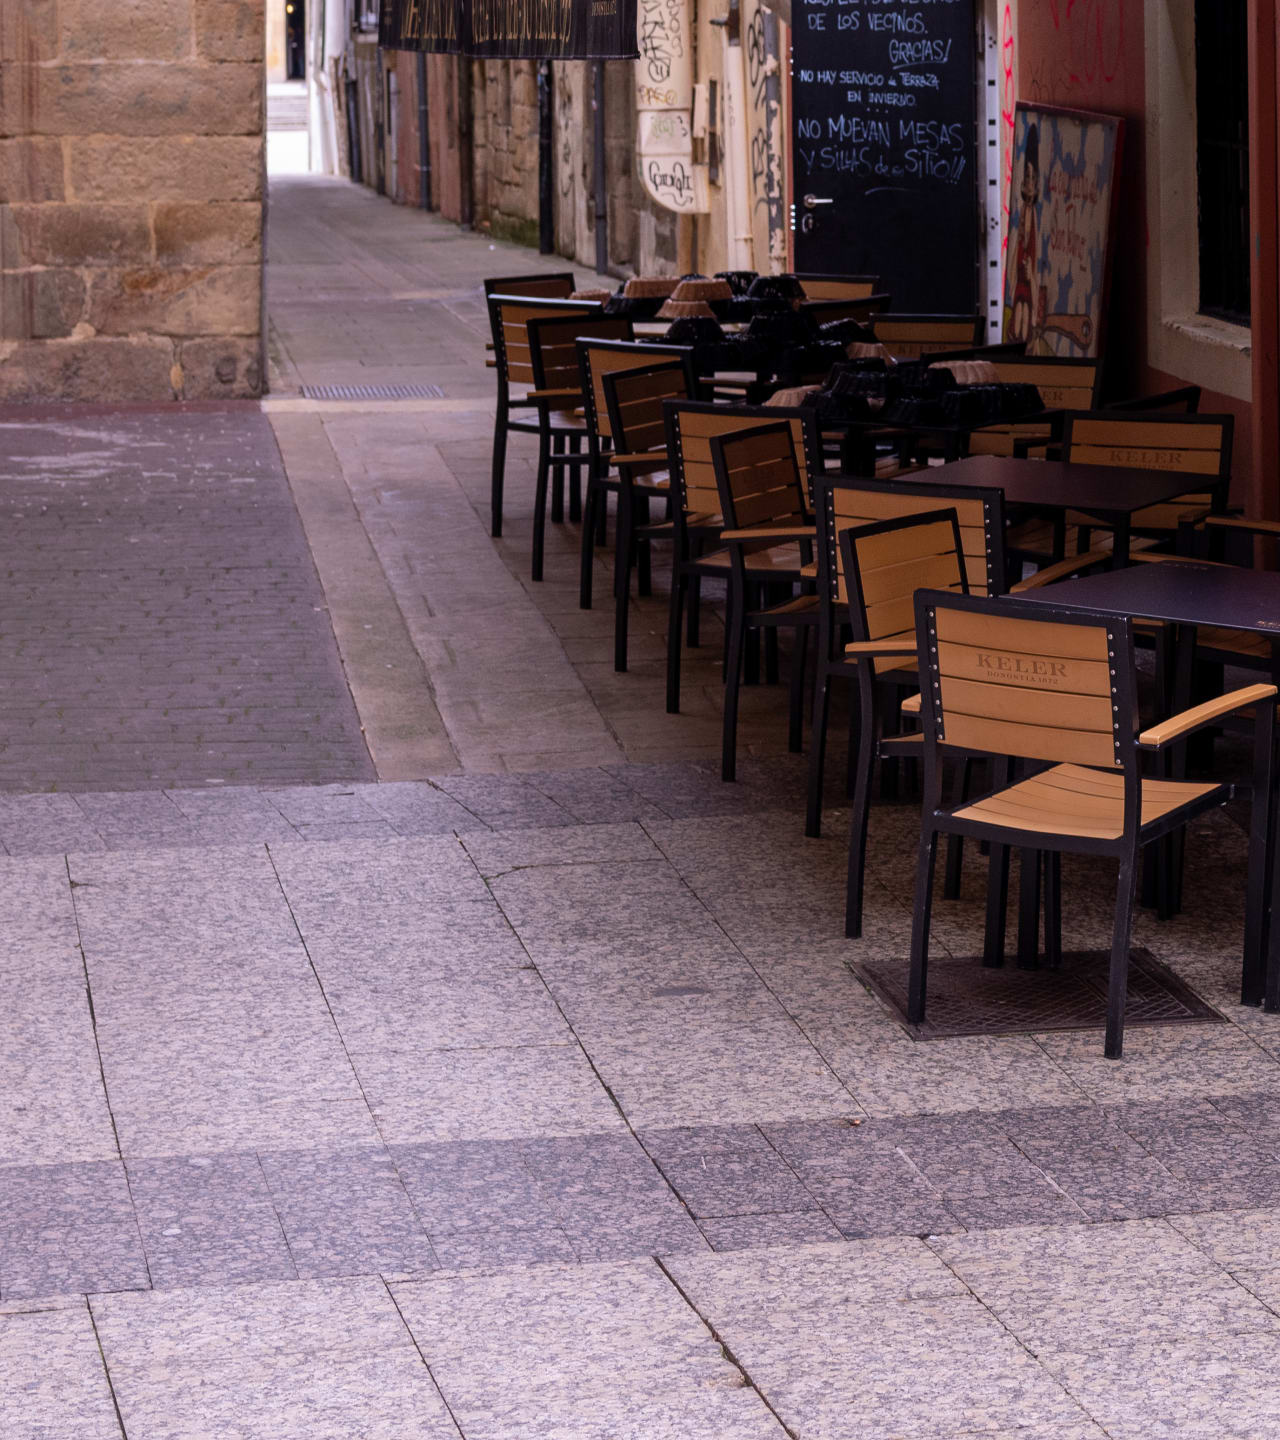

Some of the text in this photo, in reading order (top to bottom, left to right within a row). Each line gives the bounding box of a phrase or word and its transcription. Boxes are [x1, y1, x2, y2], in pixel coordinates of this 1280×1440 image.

[808, 13, 826, 30] DE
[837, 11, 860, 30] LOS
[888, 38, 952, 66] GRACIAS!
[800, 70, 814, 83] NO
[817, 71, 837, 86] HAY
[839, 71, 884, 87] SERVICIO
[847, 90, 862, 102] EN
[798, 114, 964, 152] NO MUEVAN MESAS
[800, 149, 815, 175] Y
[976, 653, 1068, 677] KELER
